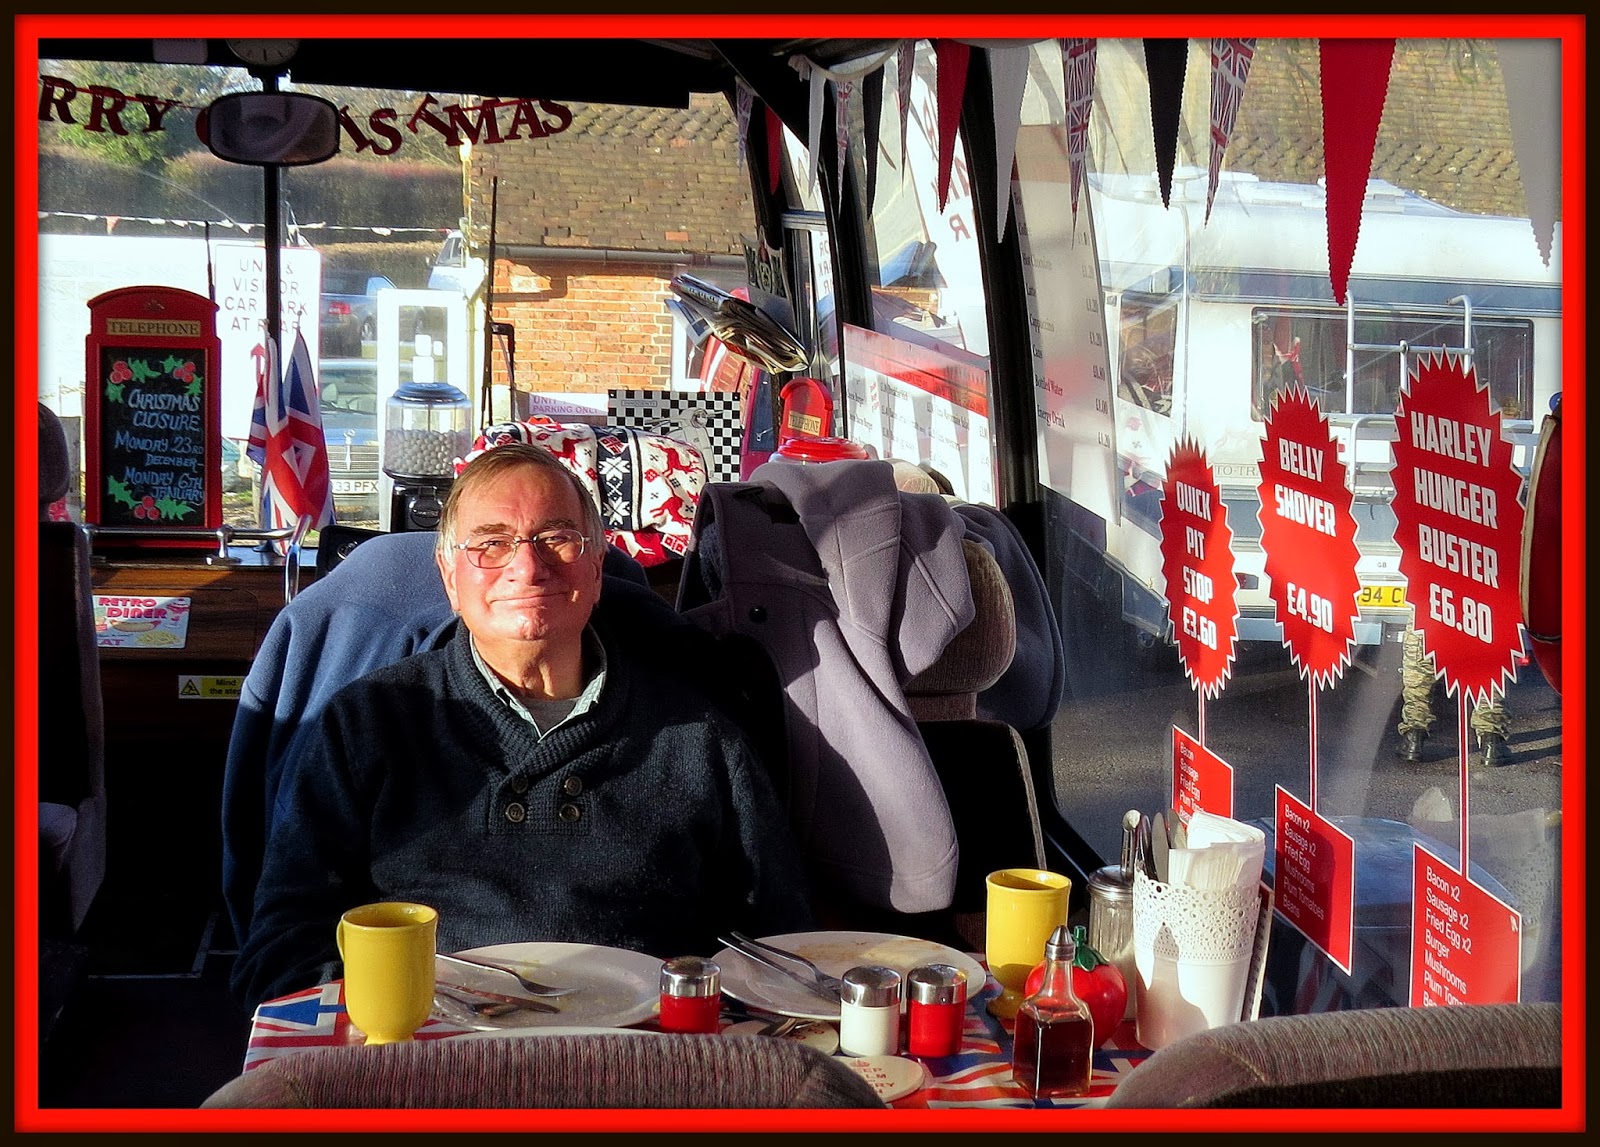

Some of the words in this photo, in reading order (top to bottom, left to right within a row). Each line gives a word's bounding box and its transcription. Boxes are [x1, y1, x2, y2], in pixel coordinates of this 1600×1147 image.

[196, 92, 573, 156] ISTMAS
[233, 277, 299, 295] VISIOR
[224, 296, 257, 312] CAR
[109, 320, 200, 336] TELEPHONE
[231, 316, 250, 332] AT
[257, 318, 301, 334] RAR
[128, 388, 201, 412] CHRISTMAS
[532, 405, 573, 414] PARKING
[133, 410, 201, 432] CLOSURE
[788, 411, 821, 434] TELEPHONE
[1051, 410, 1066, 429] Drink
[1410, 410, 1492, 468] HARLEY
[1278, 437, 1324, 483] BELLY
[354, 481, 379, 492] PFX
[1175, 480, 1212, 522] QUICK
[1413, 466, 1498, 530] HUNGER
[1274, 483, 1337, 538] SHOVER
[1185, 525, 1205, 561] PIT
[1418, 523, 1499, 589] BUSTER
[1183, 565, 1214, 605] STOP
[1357, 587, 1383, 603] 94
[98, 597, 158, 608] RETRO
[107, 607, 168, 619] DINER
[1286, 581, 1333, 634] £4.90
[1429, 582, 1493, 644] £6.80
[1183, 606, 1218, 650] £3.60
[209, 687, 223, 695] the
[215, 678, 237, 687] Mind
[1180, 741, 1194, 761] Bacon
[1180, 758, 1199, 782] Sausage
[1179, 789, 1191, 807] Plum
[1180, 773, 1191, 791] Fried
[1191, 782, 1201, 801] Egg
[1284, 803, 1302, 828] Bacon
[1302, 819, 1311, 833] x2
[1284, 822, 1308, 851] Sausage
[1308, 842, 1317, 857] x2
[1284, 840, 1299, 862] Fried
[1299, 851, 1311, 874] Egg
[1284, 858, 1315, 893] Mushrooms
[1426, 865, 1450, 893] Bacon
[1450, 885, 1460, 903] x2
[1283, 876, 1298, 898] Plum
[1298, 887, 1325, 921] Tomatoes
[1283, 894, 1300, 919] Beans
[1426, 887, 1458, 924] Sausage
[1459, 913, 1469, 931] x2
[1425, 908, 1445, 932] Fried
[1445, 924, 1461, 950] Egg
[1461, 937, 1472, 955] x2
[1425, 929, 1450, 959] Burger
[1423, 971, 1443, 998] Plum
[1424, 949, 1467, 995] Mushrooms
